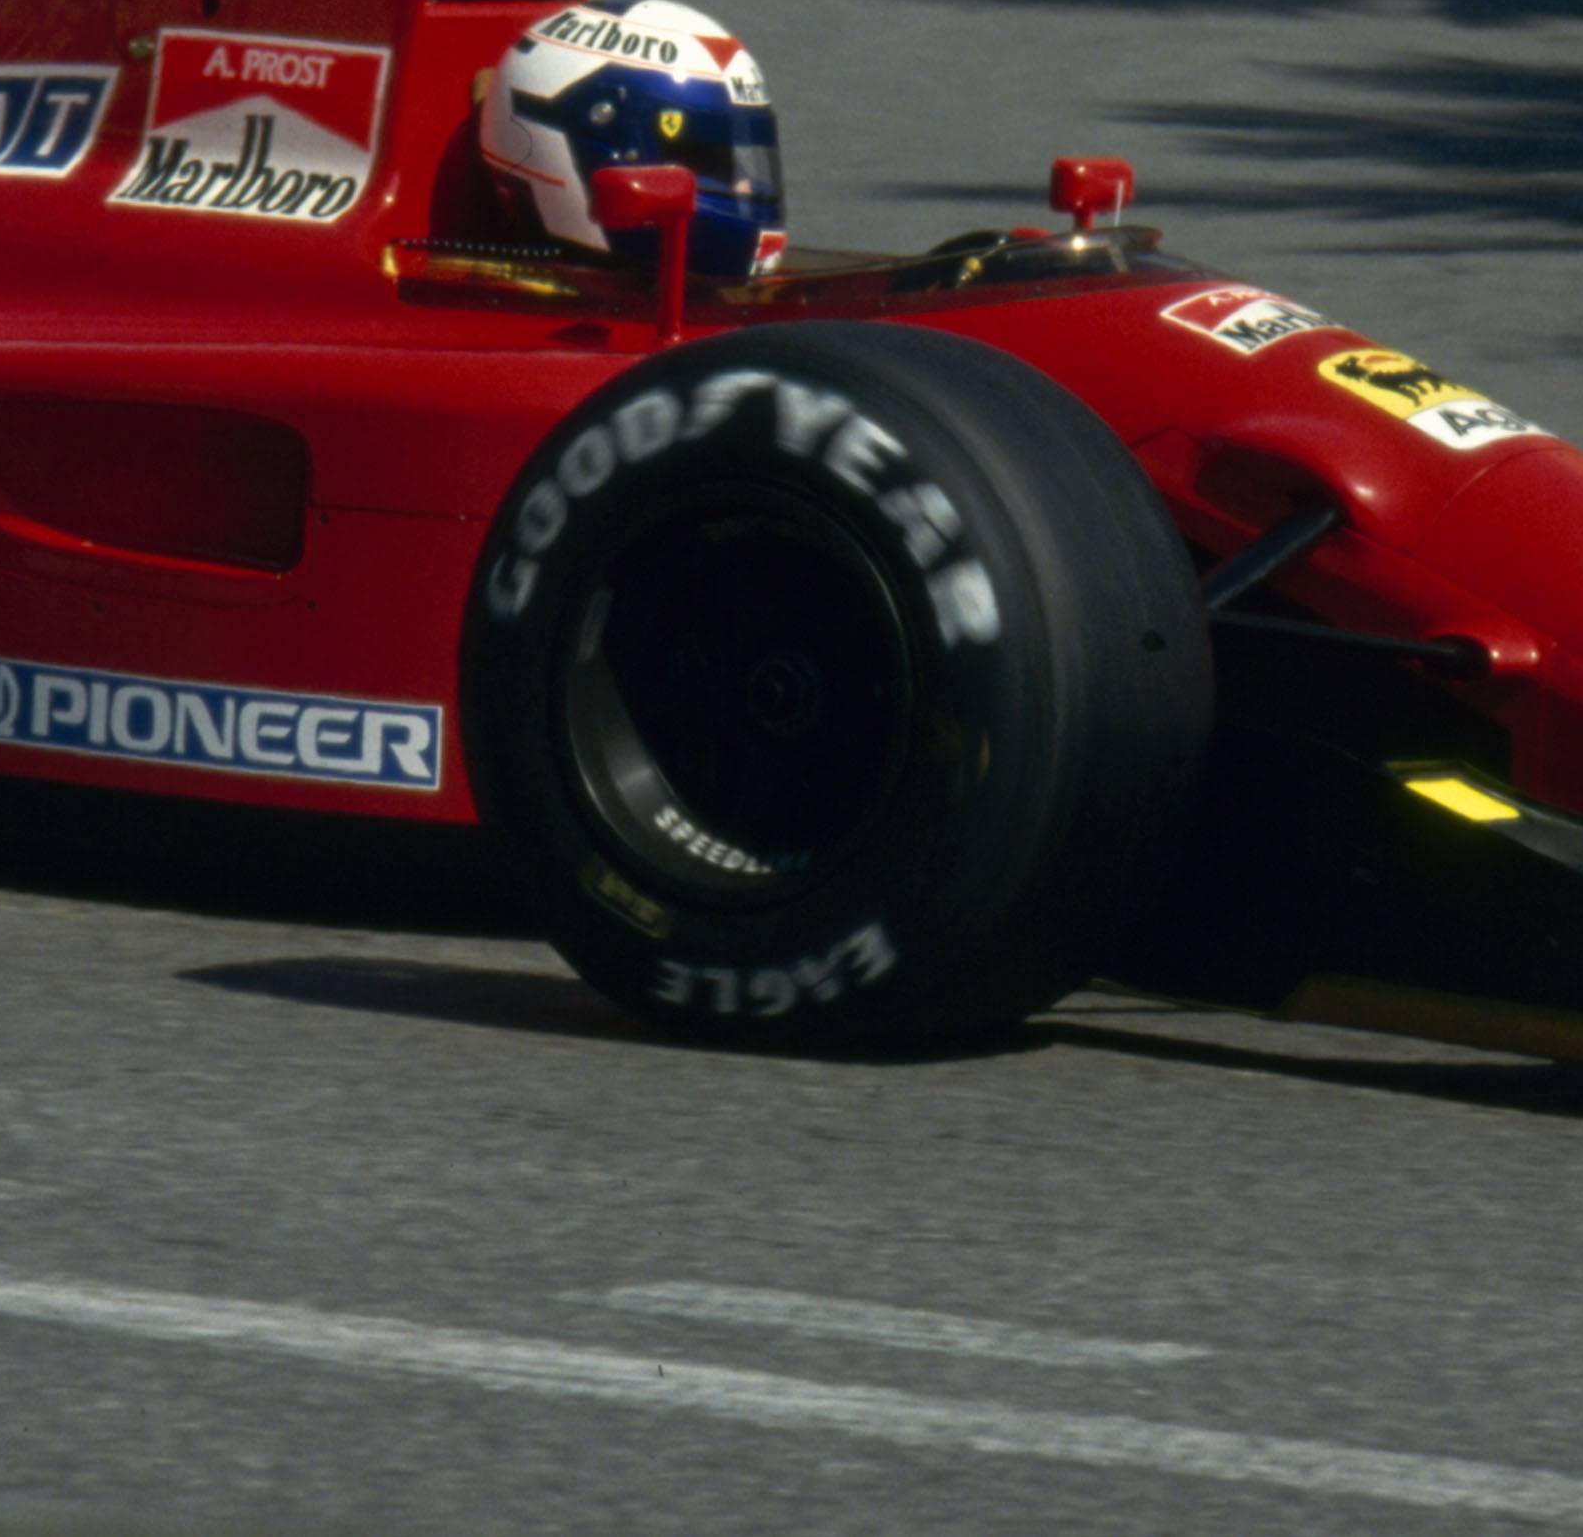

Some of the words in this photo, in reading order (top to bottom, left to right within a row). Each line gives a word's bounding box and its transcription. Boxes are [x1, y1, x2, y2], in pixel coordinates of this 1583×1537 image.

[203, 45, 236, 79] A.
[240, 47, 335, 90] PROST
[537, 8, 679, 65] Marlboro
[116, 114, 358, 220] Marlboro
[485, 370, 1002, 650] GOODYEAR
[31, 673, 432, 778] PIONEER
[653, 923, 899, 1019] EAGLE
